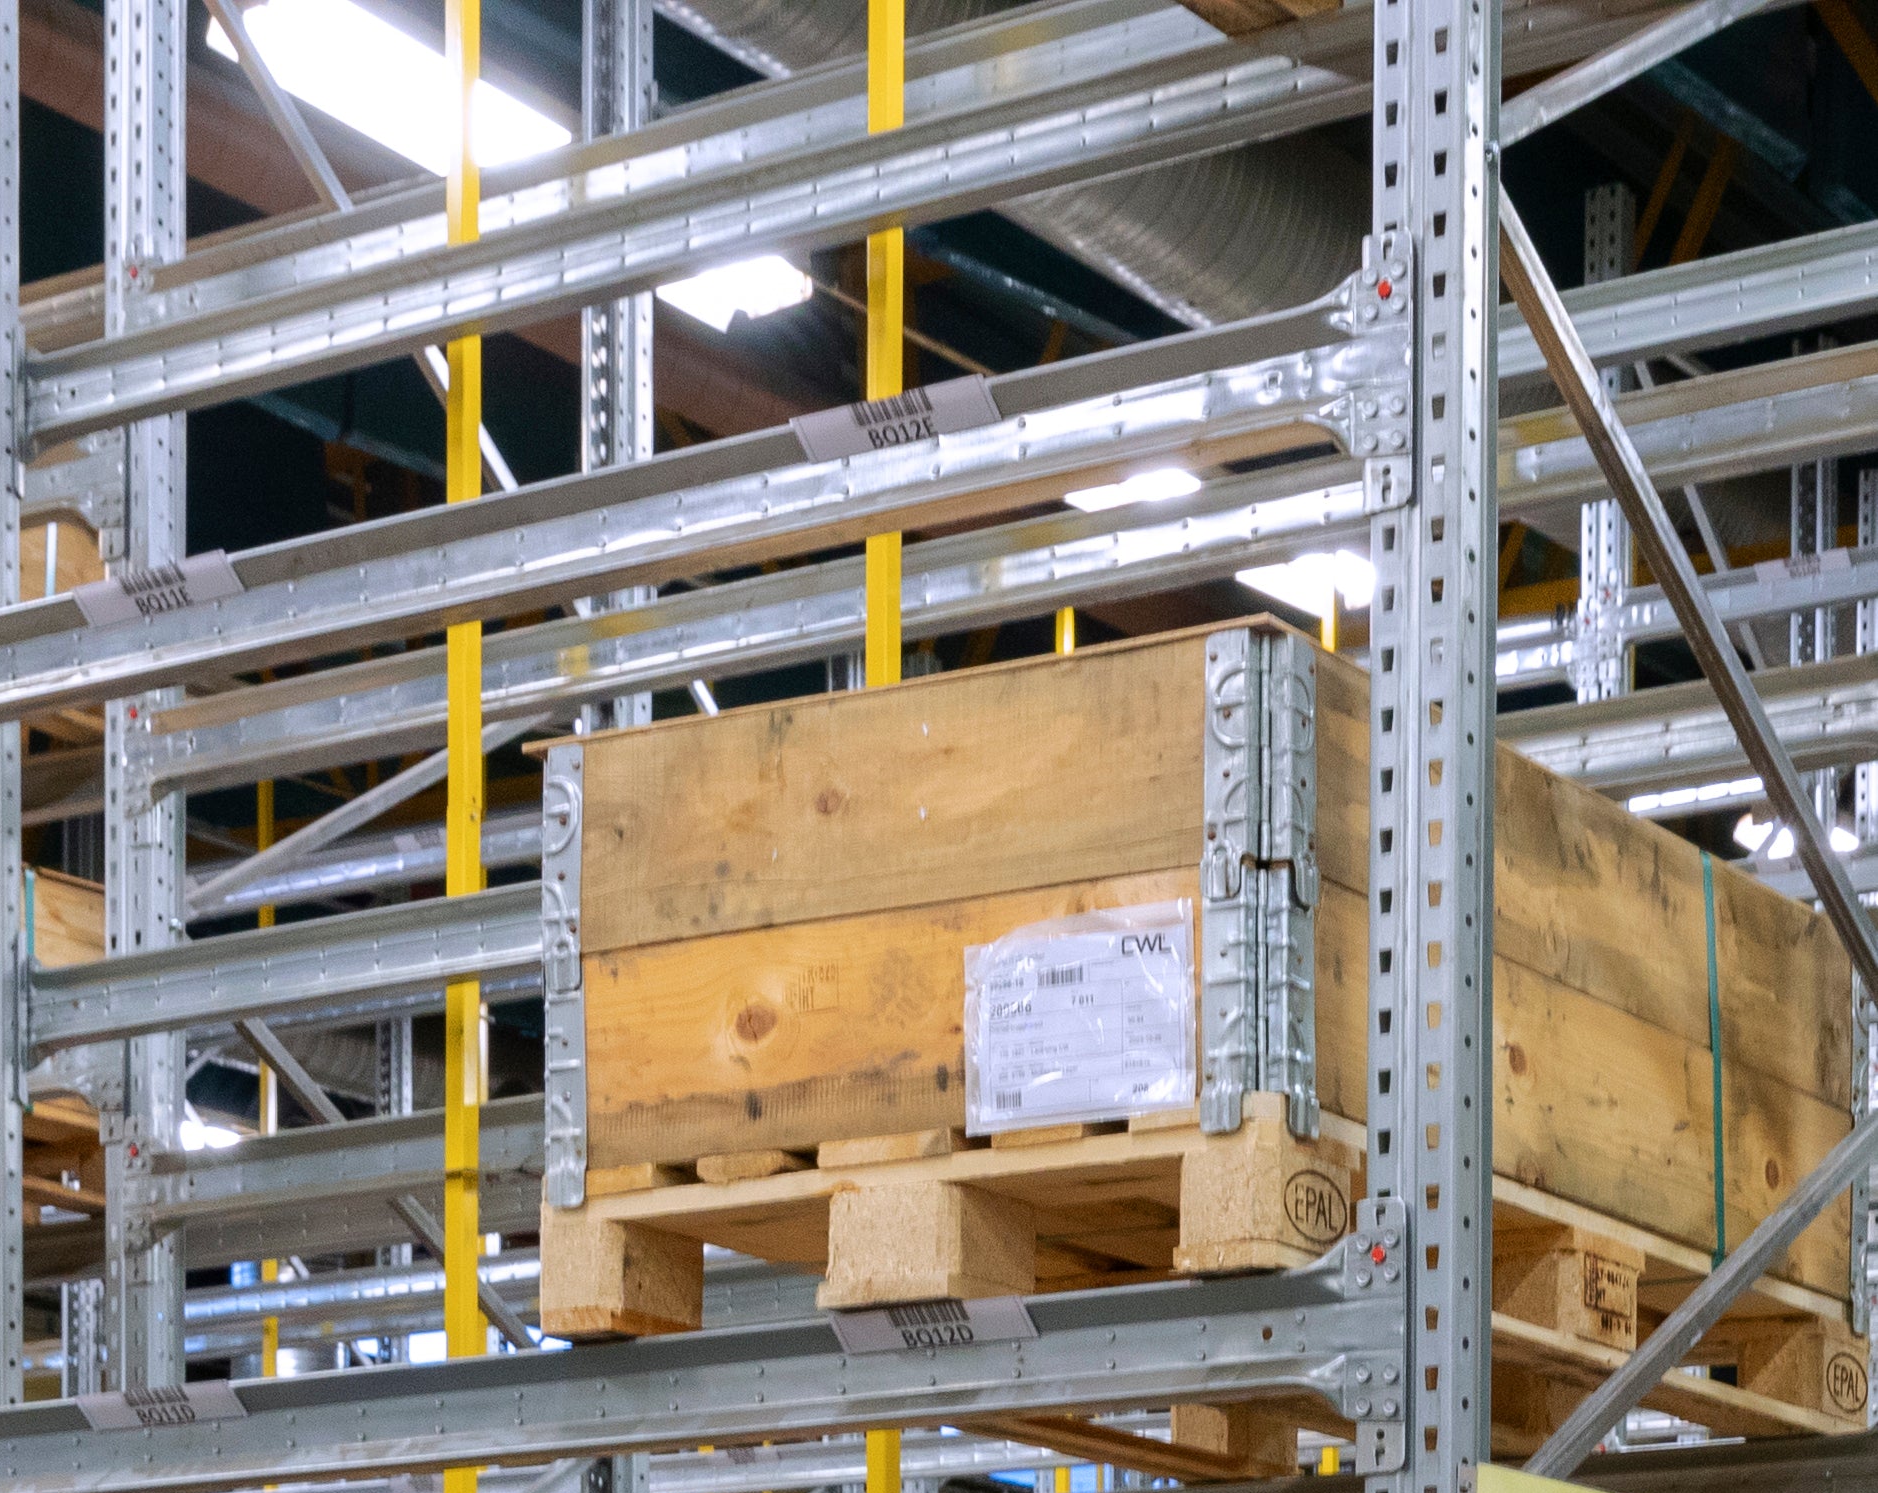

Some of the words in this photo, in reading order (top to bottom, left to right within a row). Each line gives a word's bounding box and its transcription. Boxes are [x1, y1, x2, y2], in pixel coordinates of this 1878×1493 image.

[1122, 932, 1172, 957] CWL
[1295, 1183, 1338, 1233] EPAL
[901, 1324, 974, 1348] BQ12D
[1833, 1363, 1860, 1403] EPAL
[135, 1403, 196, 1424] BQ11D
